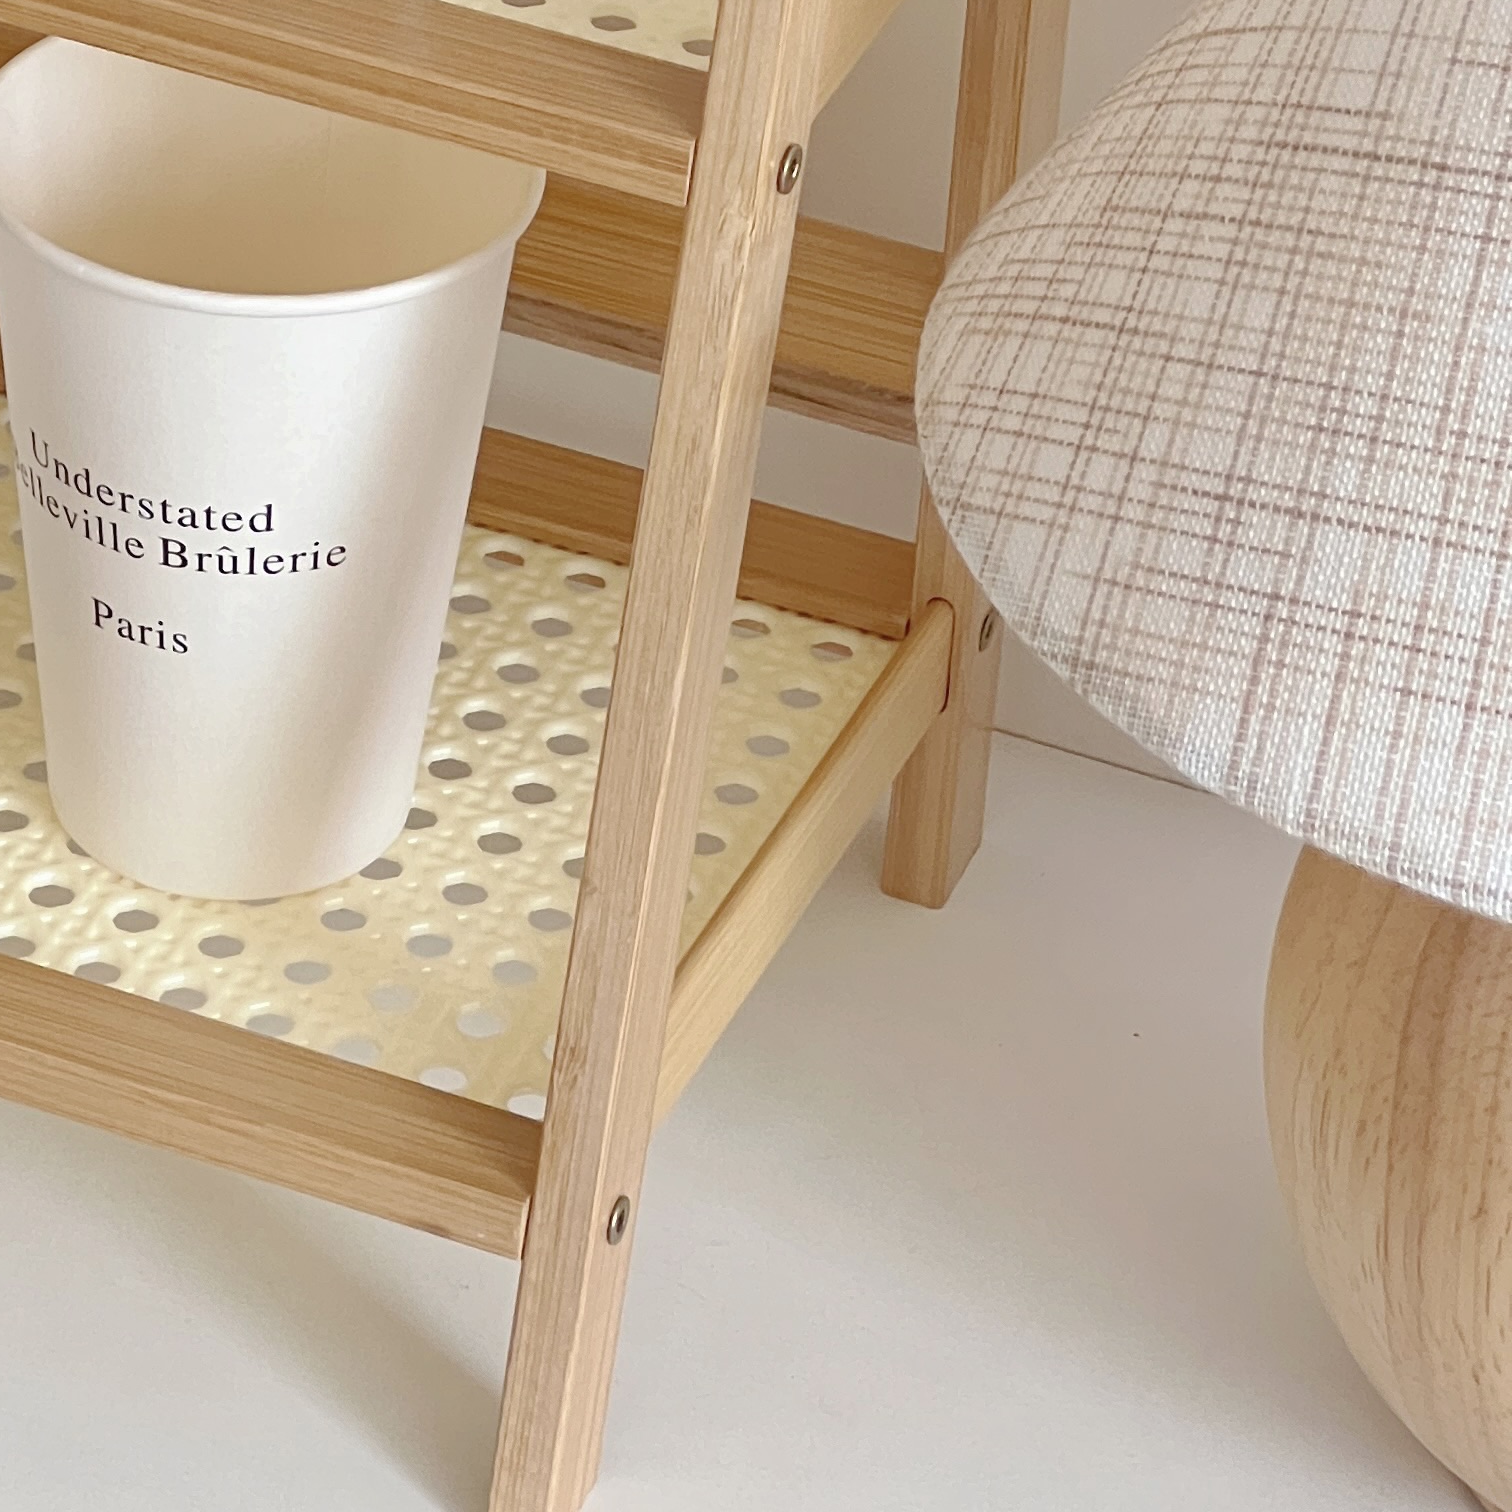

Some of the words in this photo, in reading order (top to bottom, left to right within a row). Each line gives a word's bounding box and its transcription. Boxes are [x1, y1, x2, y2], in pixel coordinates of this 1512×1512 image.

[29, 426, 275, 533] Understated
[158, 535, 348, 576] Brûlerie
[91, 596, 189, 654] Paris
